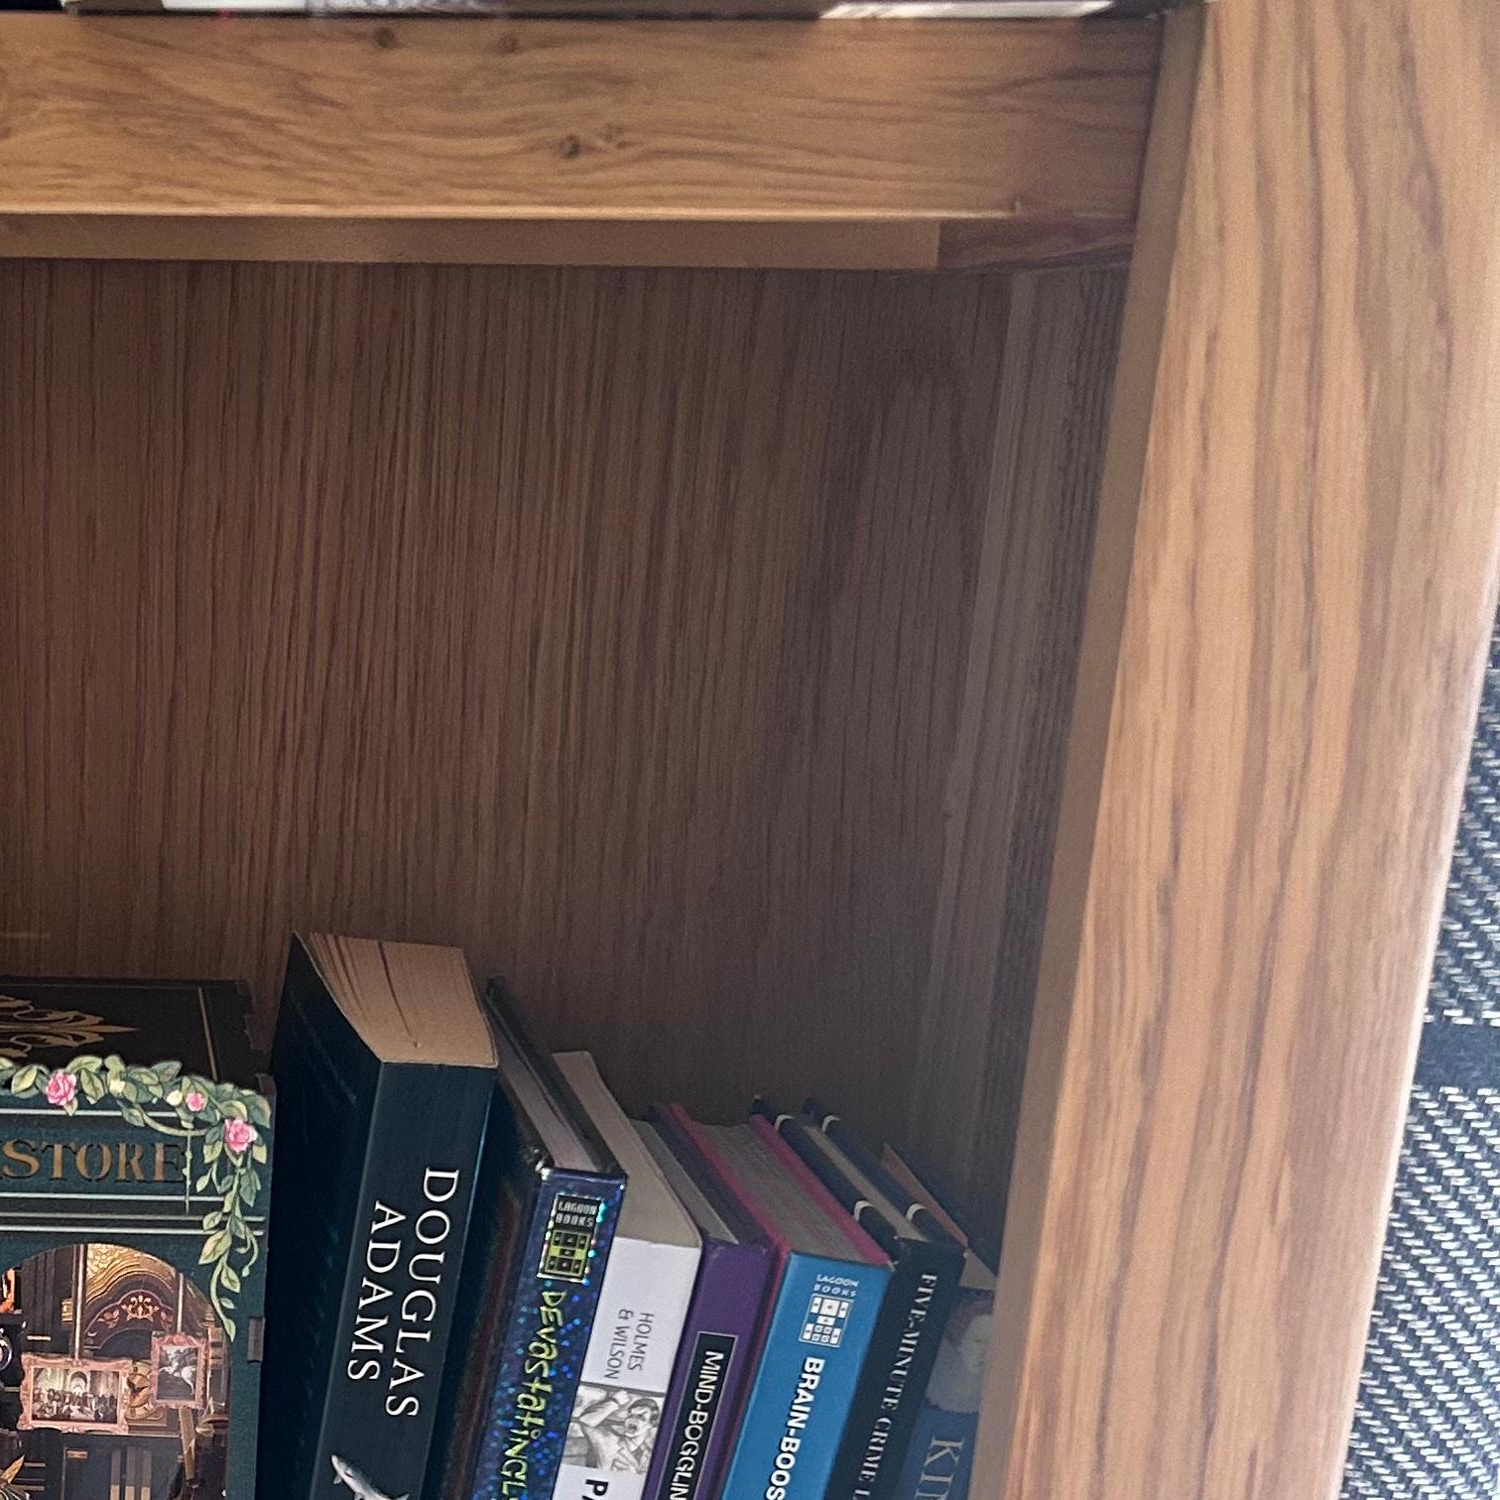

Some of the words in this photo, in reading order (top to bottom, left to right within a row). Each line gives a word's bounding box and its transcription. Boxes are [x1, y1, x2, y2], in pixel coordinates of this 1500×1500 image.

[346, 1199, 406, 1382] ADAMS
[385, 1166, 460, 1418] DOUGLAS
[627, 1312, 656, 1373] HOLMES
[883, 1273, 938, 1412] FIVE-MINUTE
[604, 1324, 632, 1381] WILSON
[861, 1415, 894, 1484] CRIME
